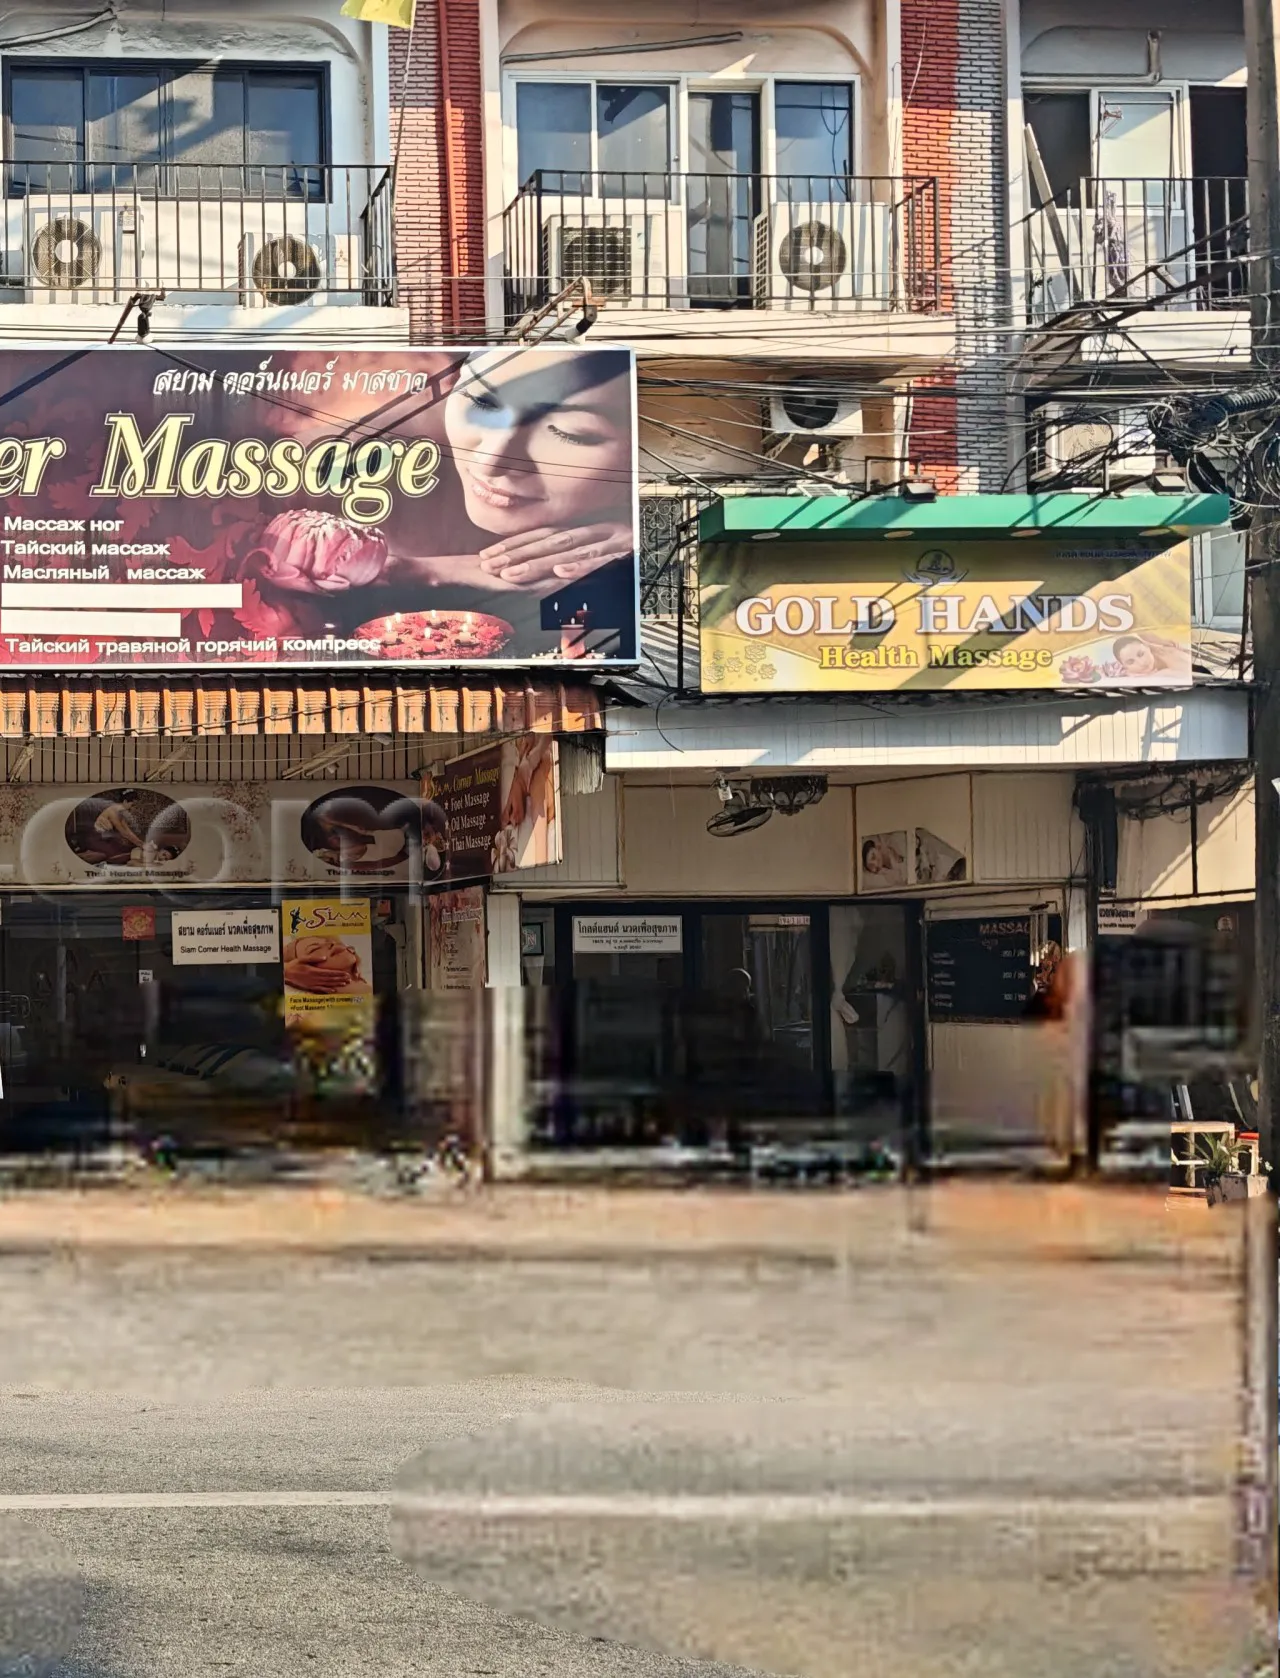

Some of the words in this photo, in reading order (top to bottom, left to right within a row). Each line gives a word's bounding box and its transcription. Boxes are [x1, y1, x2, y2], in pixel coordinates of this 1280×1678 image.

[153, 368, 217, 395] สยาม
[89, 410, 442, 524] Massage
[4, 516, 86, 531] Массаж
[90, 519, 124, 531] ног
[0, 540, 86, 555] Тайский
[91, 543, 171, 555] массаж
[3, 564, 109, 579] Масляный
[127, 567, 206, 579] массаж
[735, 593, 897, 636] GOLD
[916, 593, 1135, 636] HANDS
[4, 638, 90, 653] Тайский
[95, 638, 190, 655] травяной
[196, 637, 277, 655] горячий
[283, 639, 382, 653] компресс
[819, 645, 918, 669] Health
[928, 645, 1054, 672] Massage
[450, 798, 463, 812] Foot
[464, 792, 490, 807] Massage
[450, 816, 461, 831] Oil
[461, 814, 486, 830] Massage
[451, 837, 465, 851] Thai
[465, 835, 491, 850] Massage
[622, 919, 678, 937] นวดเพื่อสุขภาพ
[180, 945, 197, 954] Siam
[197, 945, 219, 953] Corner
[220, 944, 242, 953] Health
[243, 944, 272, 954] Massage
